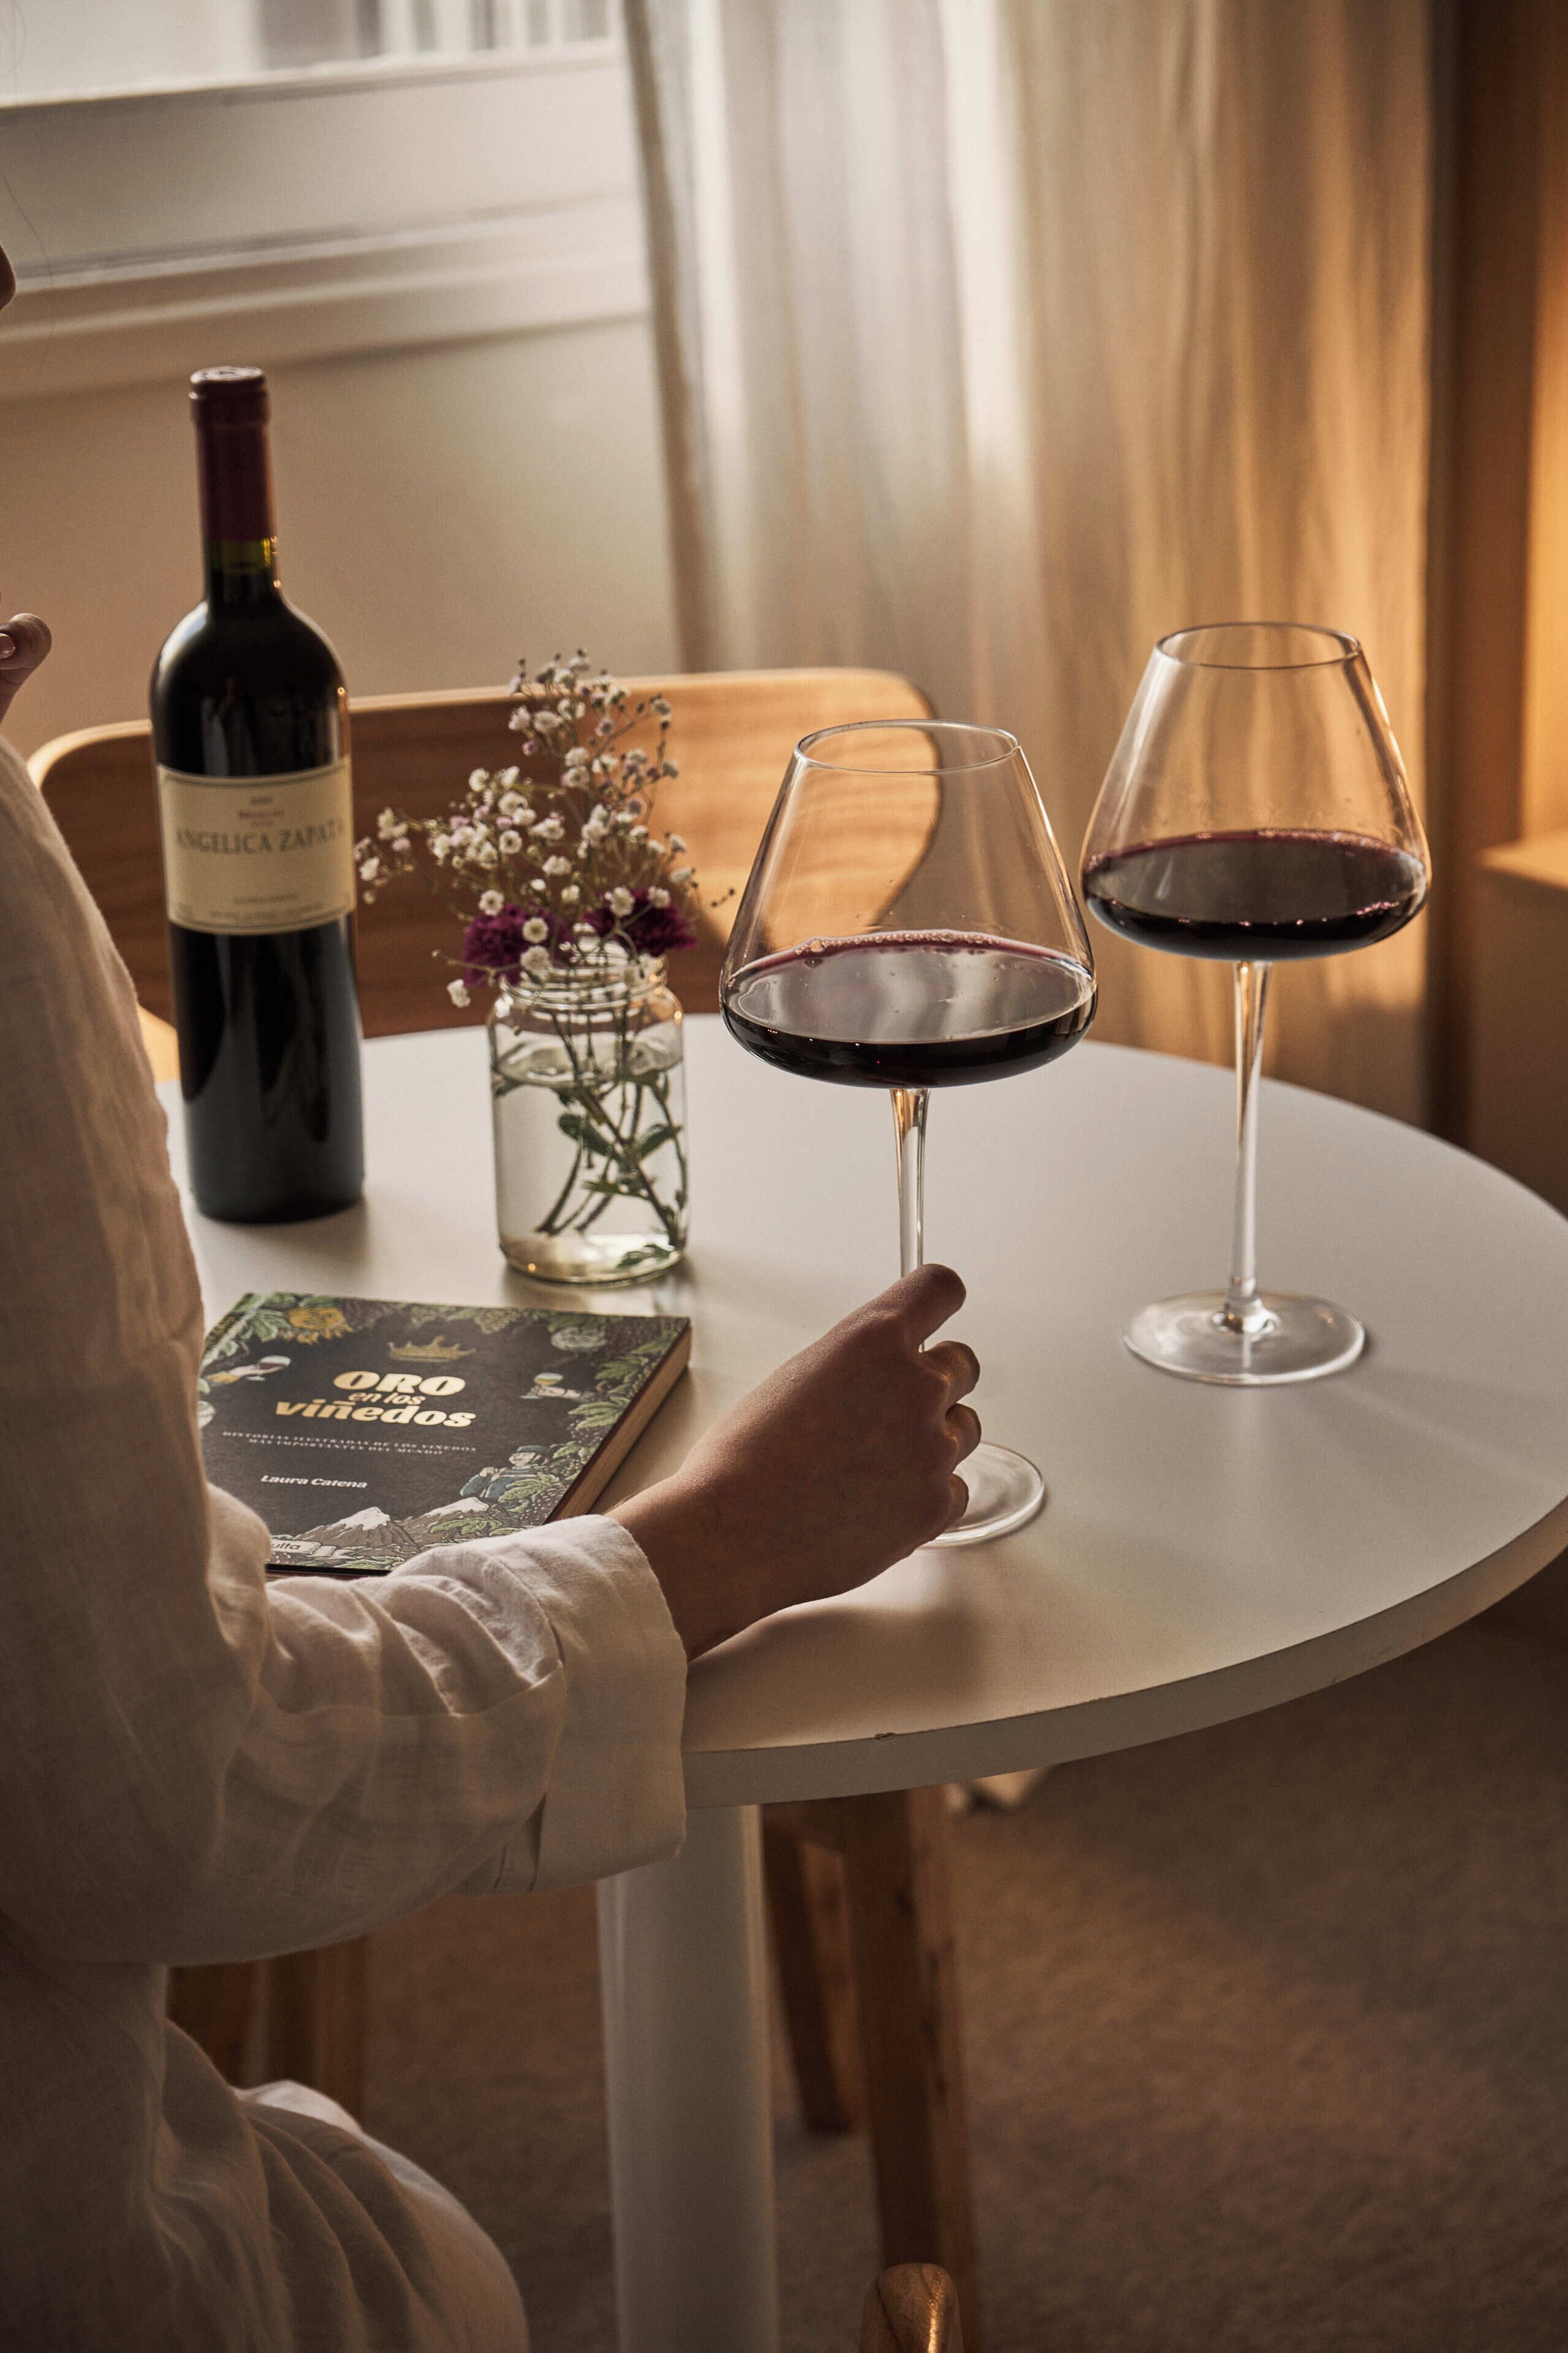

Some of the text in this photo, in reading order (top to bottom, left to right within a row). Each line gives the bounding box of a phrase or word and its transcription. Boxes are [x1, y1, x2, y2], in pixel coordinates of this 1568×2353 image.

[333, 1371, 466, 1396] ORO
[347, 1392, 426, 1405] en los
[275, 1398, 477, 1428] viñedos
[260, 1474, 368, 1488] Laura Catena
